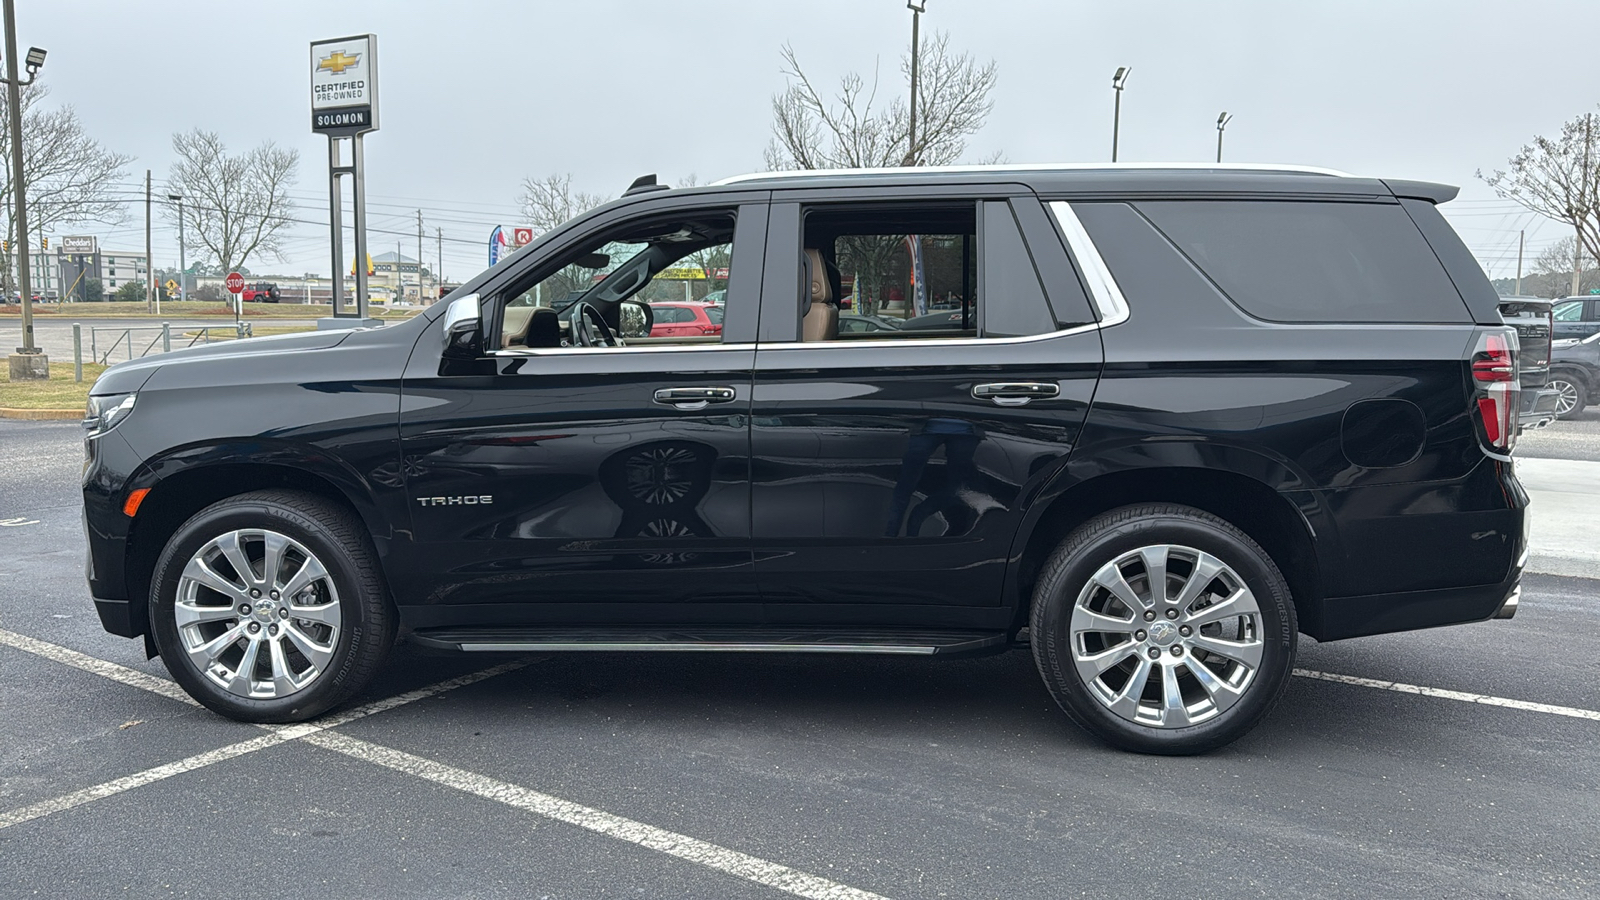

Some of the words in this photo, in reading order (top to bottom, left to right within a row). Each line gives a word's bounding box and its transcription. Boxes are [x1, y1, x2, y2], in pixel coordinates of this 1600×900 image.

[314, 80, 365, 93] CERTIFIED
[317, 89, 363, 101] PRE-OWNED
[317, 112, 363, 125] SOLOMON
[227, 279, 243, 289] STOP
[416, 495, 493, 506] TAHOE
[273, 510, 312, 529] ALENZA
[332, 626, 363, 686] BRIDGESTONE
